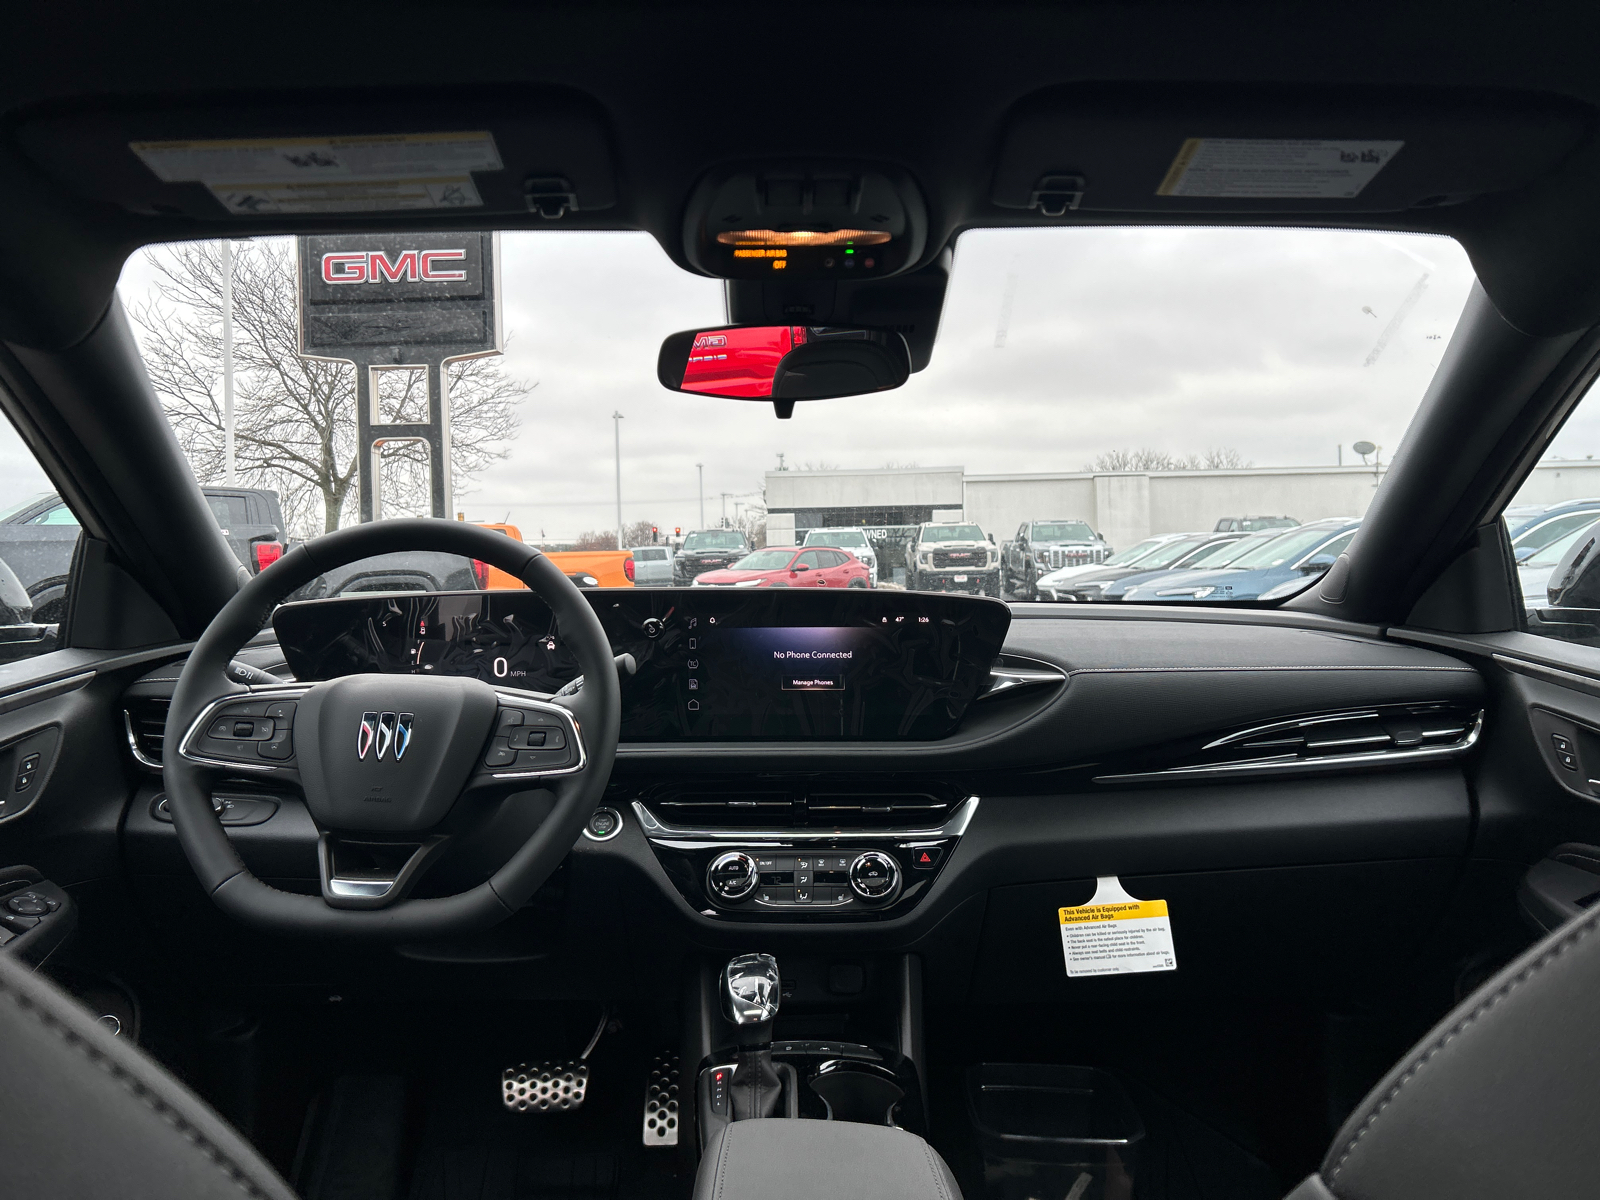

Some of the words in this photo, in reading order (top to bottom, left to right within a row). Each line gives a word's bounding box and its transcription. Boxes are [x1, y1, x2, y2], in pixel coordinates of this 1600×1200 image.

[321, 249, 467, 284] GMC
[773, 260, 787, 269] OFF
[773, 650, 785, 659] No
[786, 650, 811, 659] Phone
[811, 650, 853, 659] Connected
[493, 657, 508, 678] 0
[792, 679, 814, 687] Manage
[1102, 905, 1127, 913] Equipped
